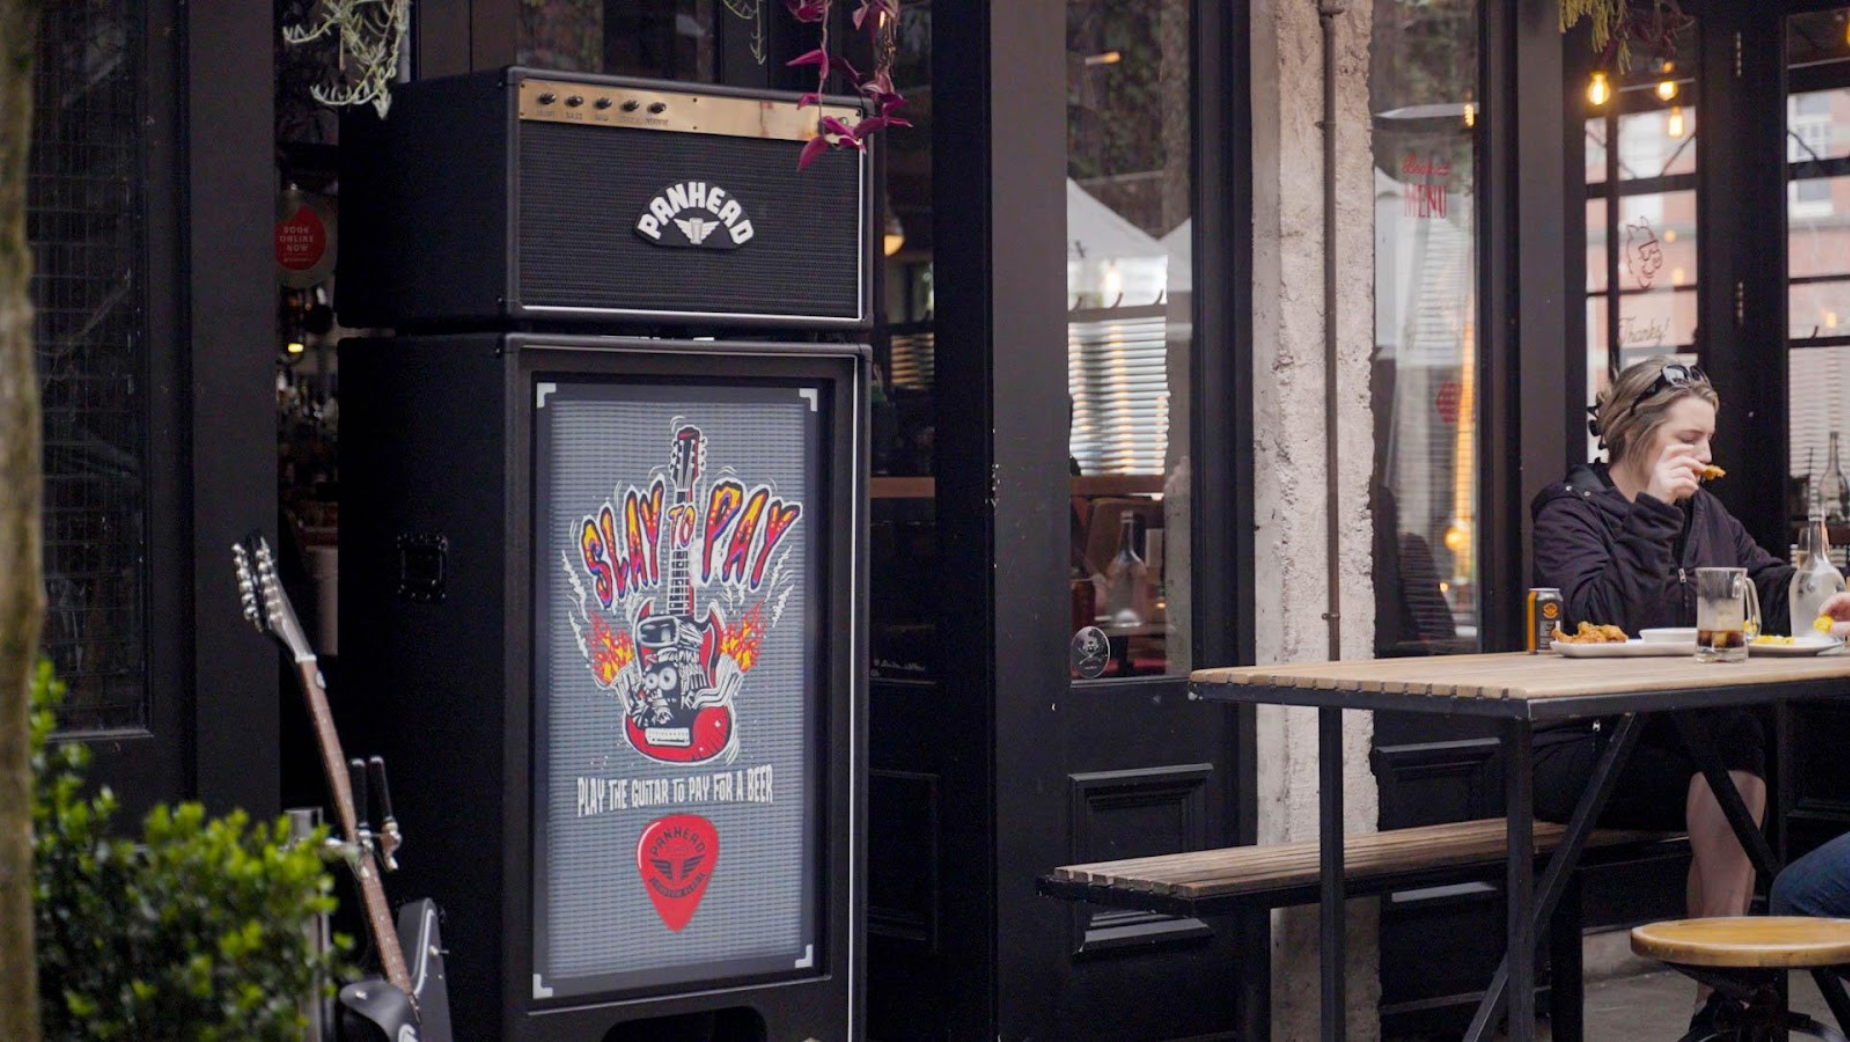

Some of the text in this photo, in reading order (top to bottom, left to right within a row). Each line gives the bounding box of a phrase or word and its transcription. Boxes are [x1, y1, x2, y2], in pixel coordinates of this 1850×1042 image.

[637, 181, 754, 244] PANHEAD
[1404, 183, 1448, 219] MENU
[280, 235, 314, 243] ONLINE
[283, 226, 309, 234] BOOK
[286, 244, 309, 252] NOW
[580, 478, 802, 609] SLAY TO PAY
[577, 764, 773, 817] PLAY THE GUITAR TO PAY FOR A BEER
[650, 825, 706, 857] PANHEAD
